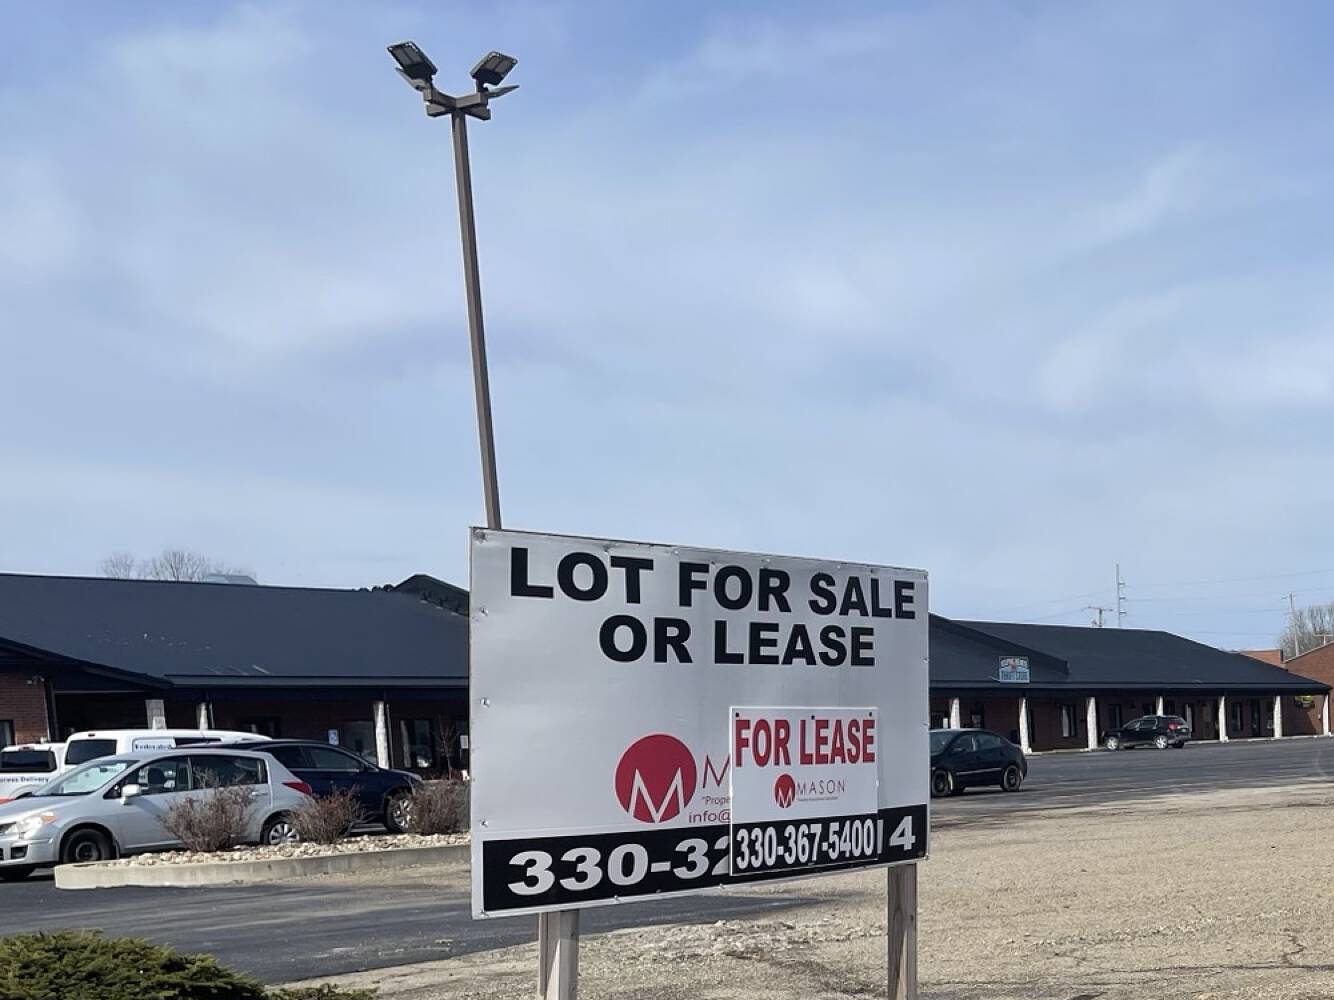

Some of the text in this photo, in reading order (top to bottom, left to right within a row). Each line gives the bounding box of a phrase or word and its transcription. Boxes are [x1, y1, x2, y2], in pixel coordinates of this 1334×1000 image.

[511, 547, 916, 619] LOT FOR SALE
[599, 615, 875, 666] OR LEASE
[735, 719, 875, 767] FOR LEASE
[797, 779, 845, 795] MASON
[736, 818, 874, 869] 330-367-5400
